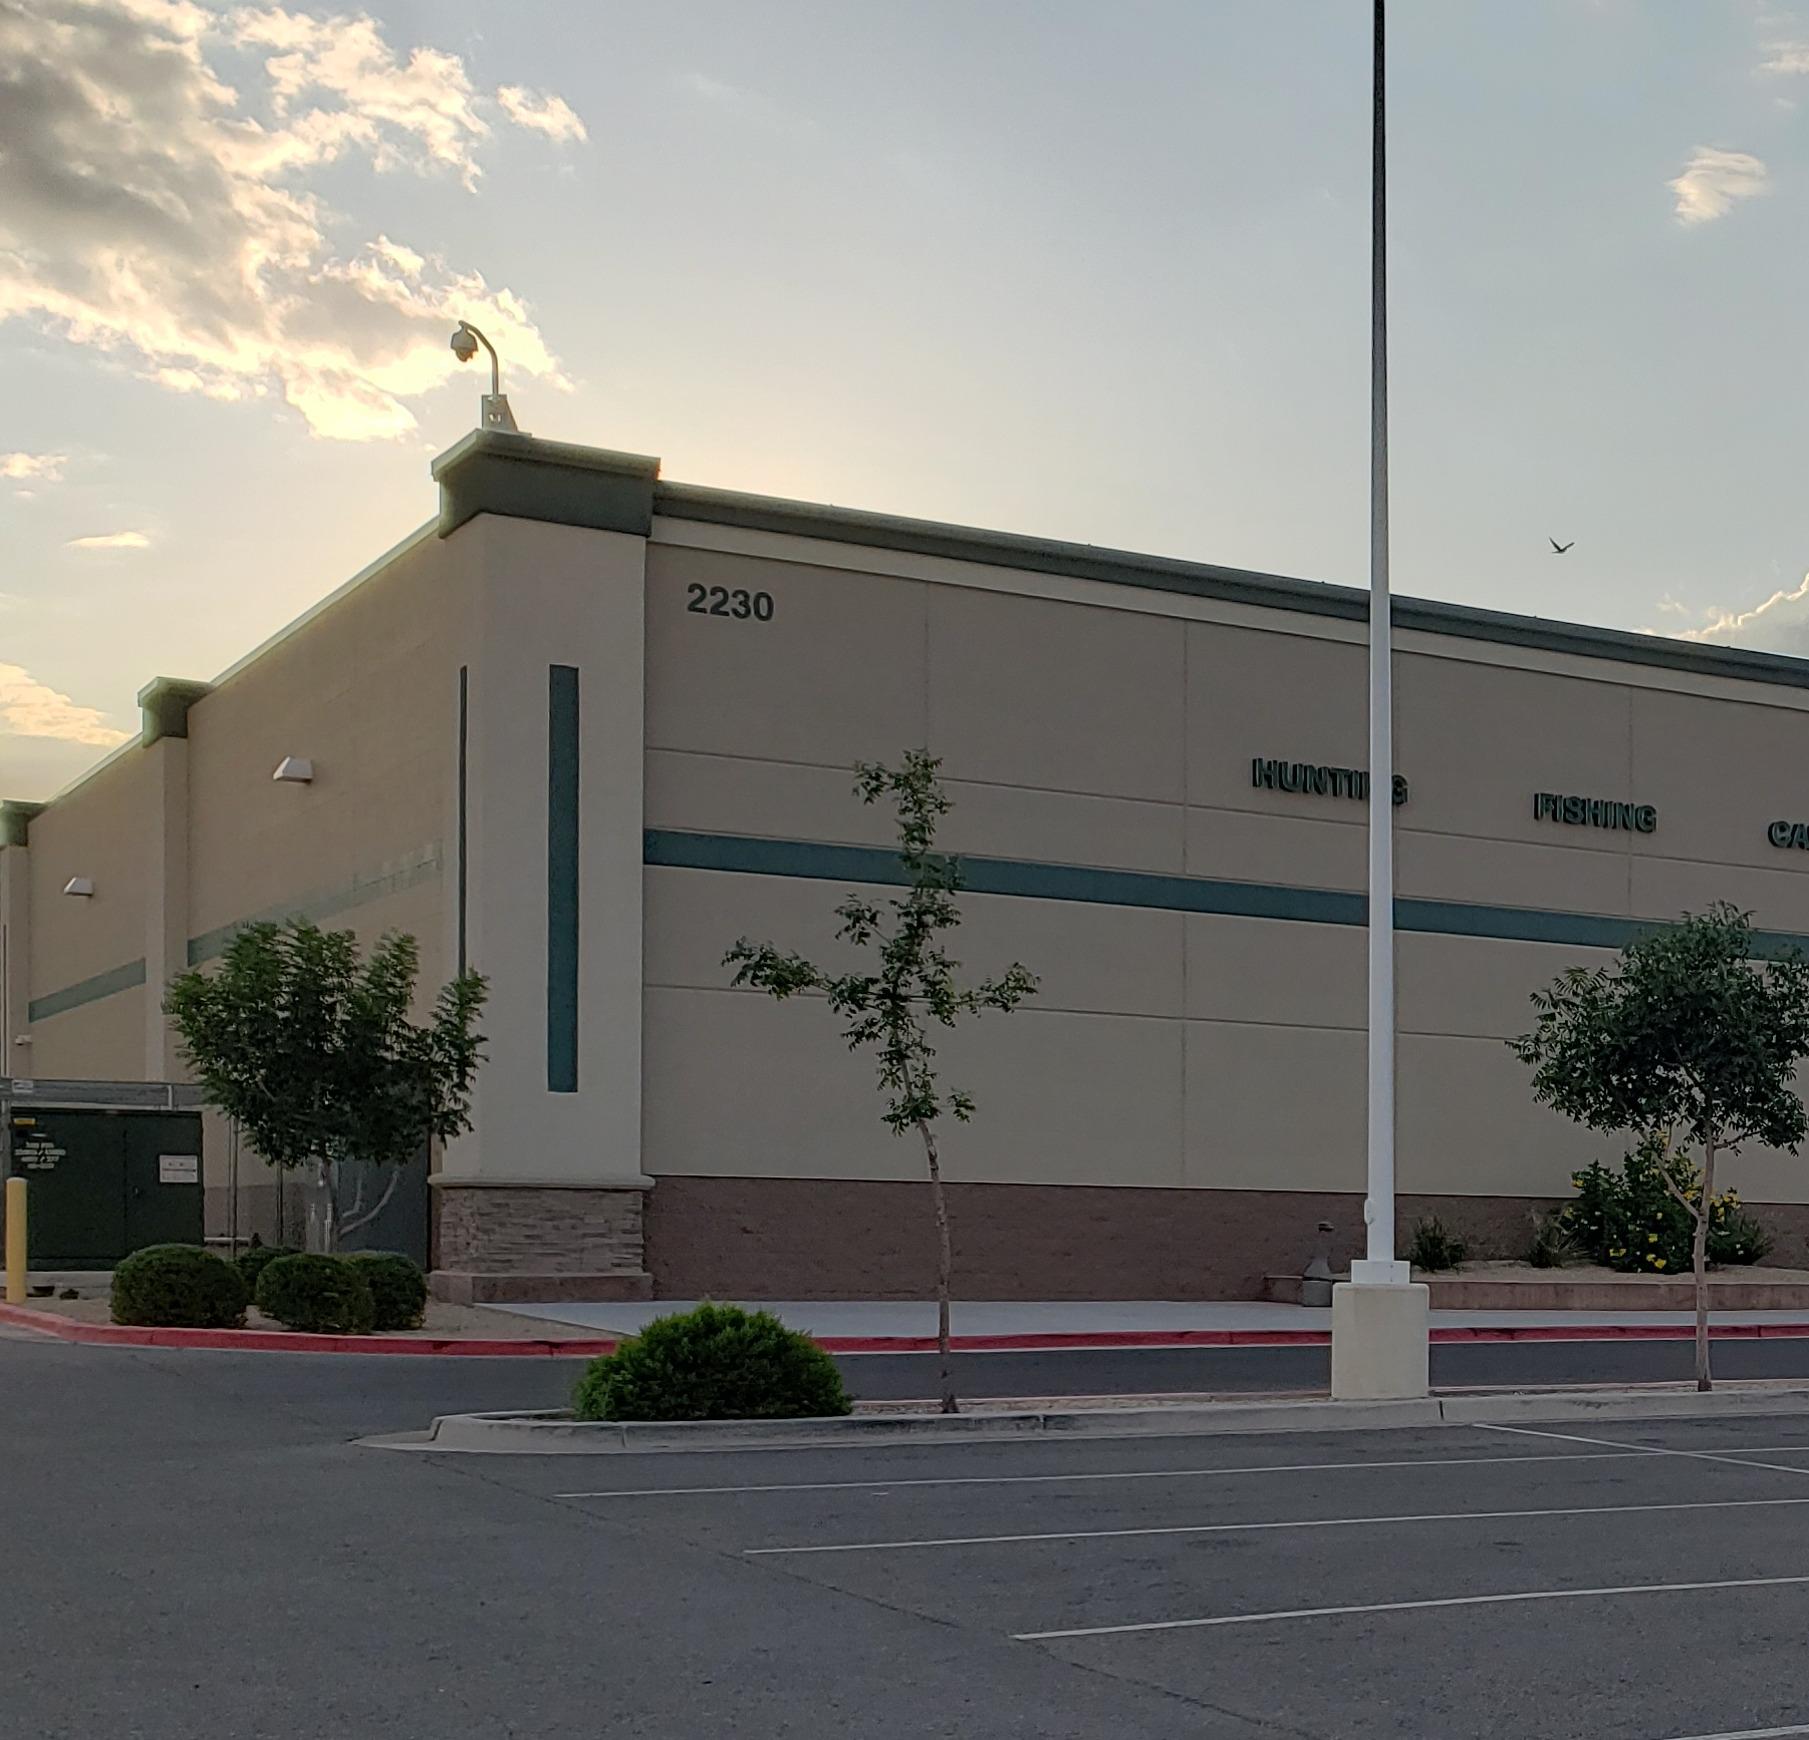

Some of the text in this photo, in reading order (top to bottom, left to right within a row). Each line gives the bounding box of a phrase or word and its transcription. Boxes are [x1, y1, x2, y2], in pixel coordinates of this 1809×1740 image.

[686, 583, 774, 622] 2230
[1252, 757, 1409, 806] HUNTIG
[1533, 792, 1657, 833] FISHING
